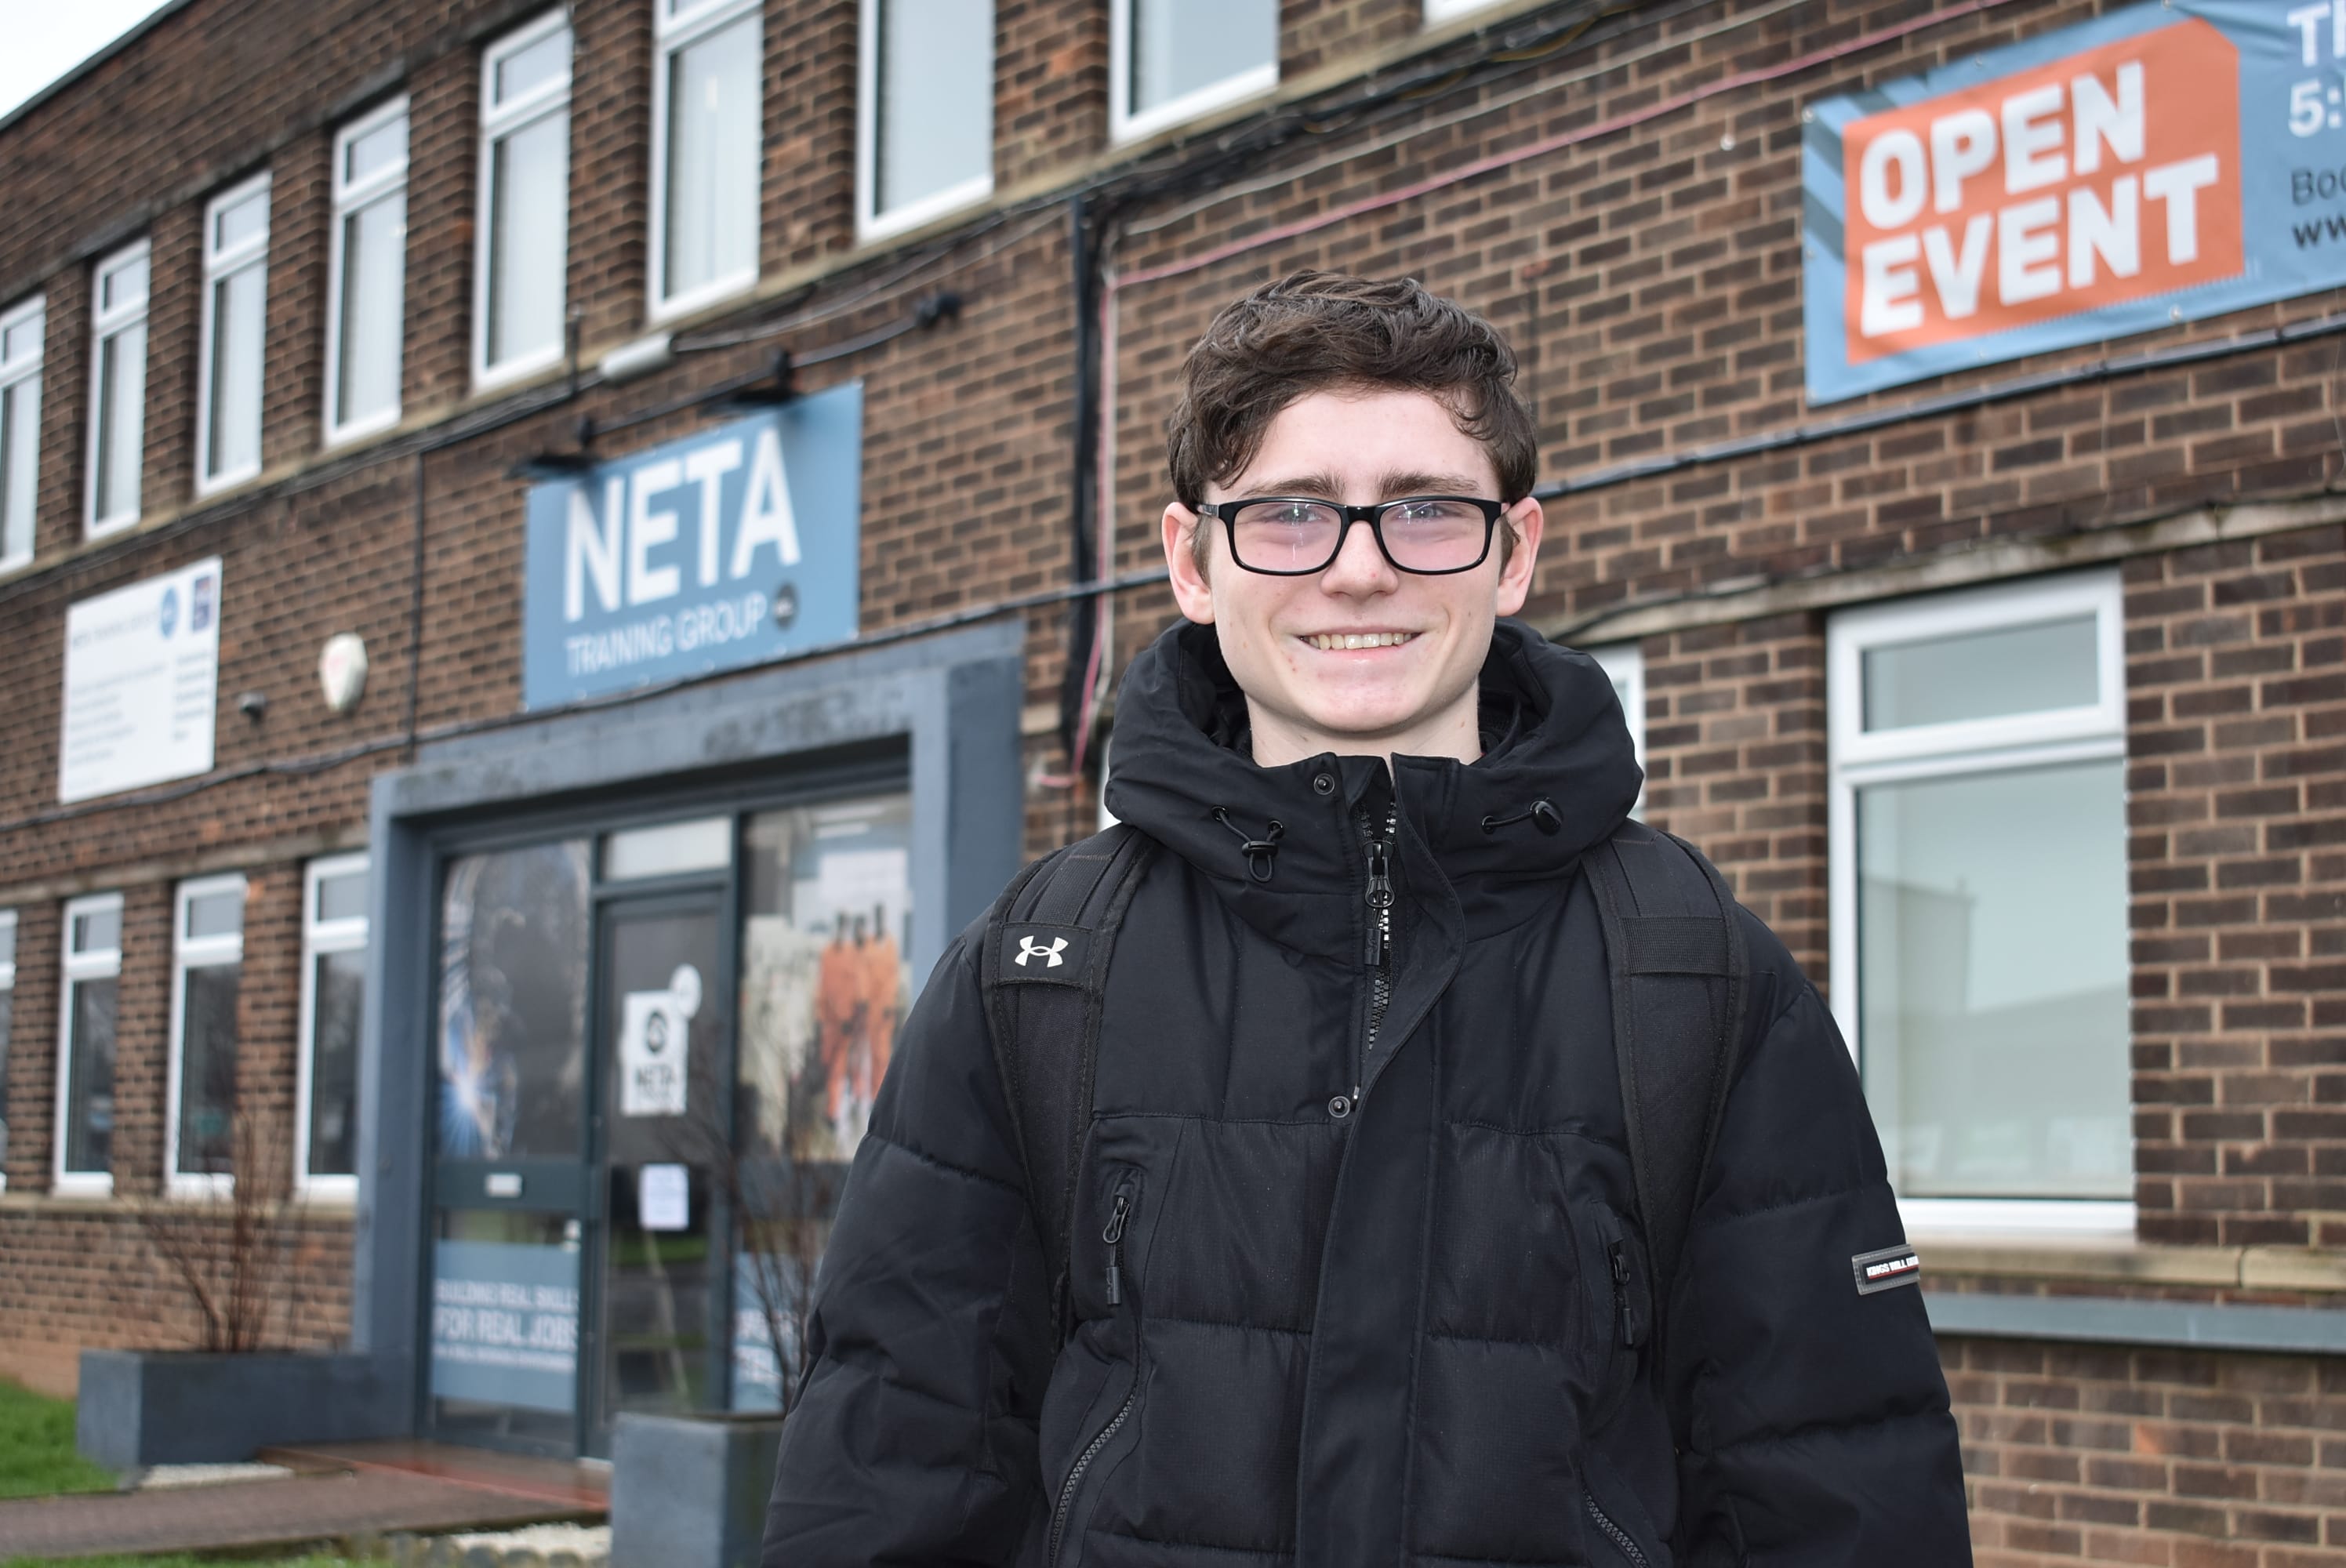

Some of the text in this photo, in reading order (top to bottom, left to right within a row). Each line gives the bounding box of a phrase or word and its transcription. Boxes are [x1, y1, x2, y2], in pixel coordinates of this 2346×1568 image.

[1860, 60, 2144, 229] OPEN
[1861, 153, 2218, 338] EVENT
[565, 426, 801, 622] NETA
[565, 591, 768, 676] TRAINING GROUP
[433, 1306, 474, 1341] FOR
[475, 1308, 523, 1347] REAL
